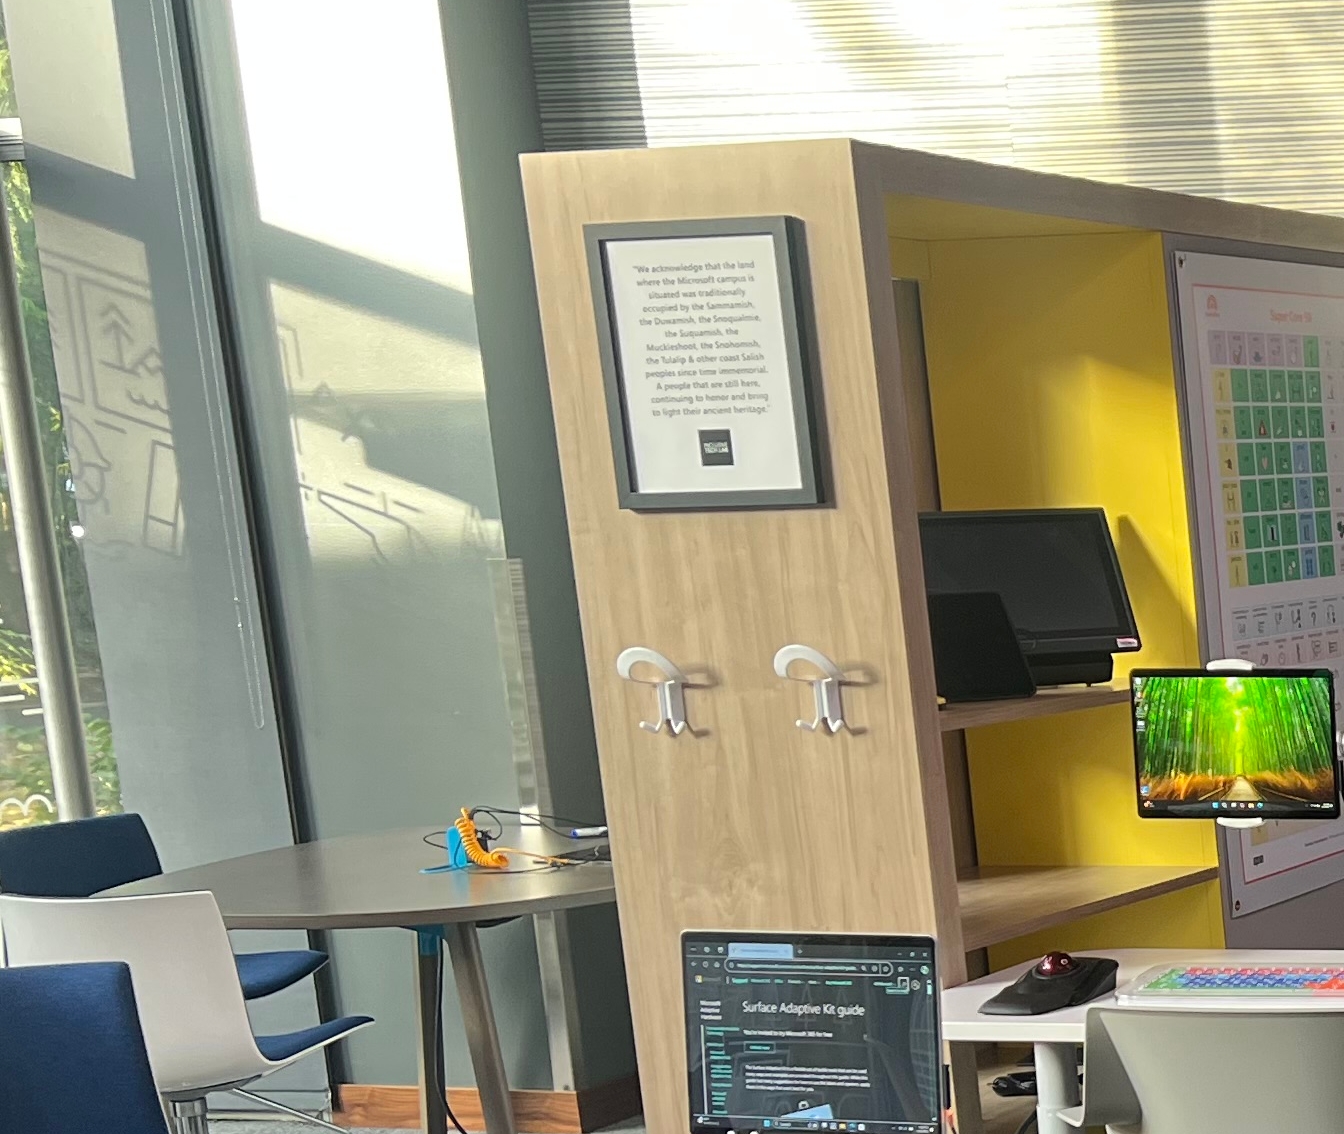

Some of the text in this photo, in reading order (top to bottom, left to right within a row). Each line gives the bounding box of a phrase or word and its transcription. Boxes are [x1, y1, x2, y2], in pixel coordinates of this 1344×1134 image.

[652, 264, 703, 273] acknowledge
[705, 262, 720, 270] that
[738, 260, 754, 269] land
[677, 276, 715, 284] Microsoft
[717, 276, 746, 284] campus
[742, 1001, 865, 1018] Surface Adaptive Kit guide
